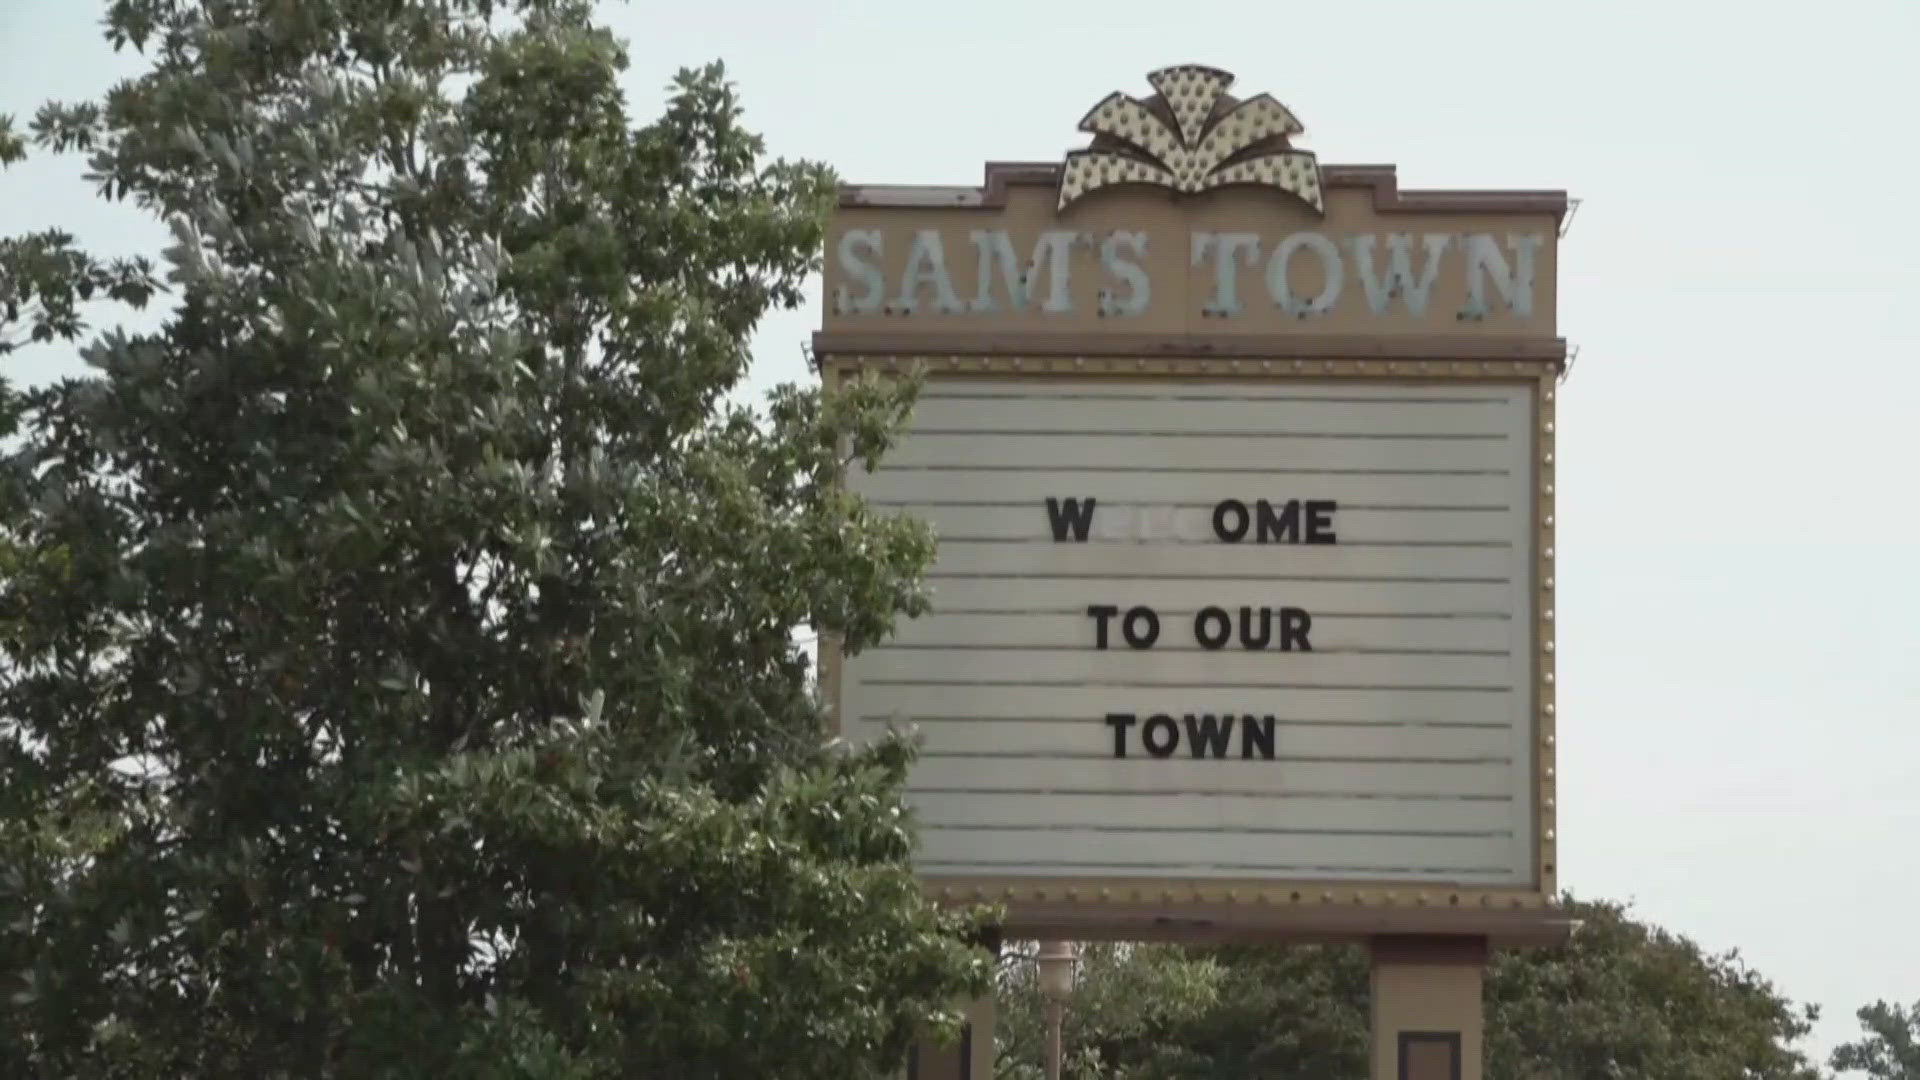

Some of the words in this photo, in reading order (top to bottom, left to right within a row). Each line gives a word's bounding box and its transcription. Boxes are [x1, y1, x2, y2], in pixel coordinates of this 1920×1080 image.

[1191, 230, 1544, 320] TOWN
[1087, 604, 1160, 650] TO
[1194, 605, 1312, 652] OUR
[1105, 712, 1276, 760] TOWN
